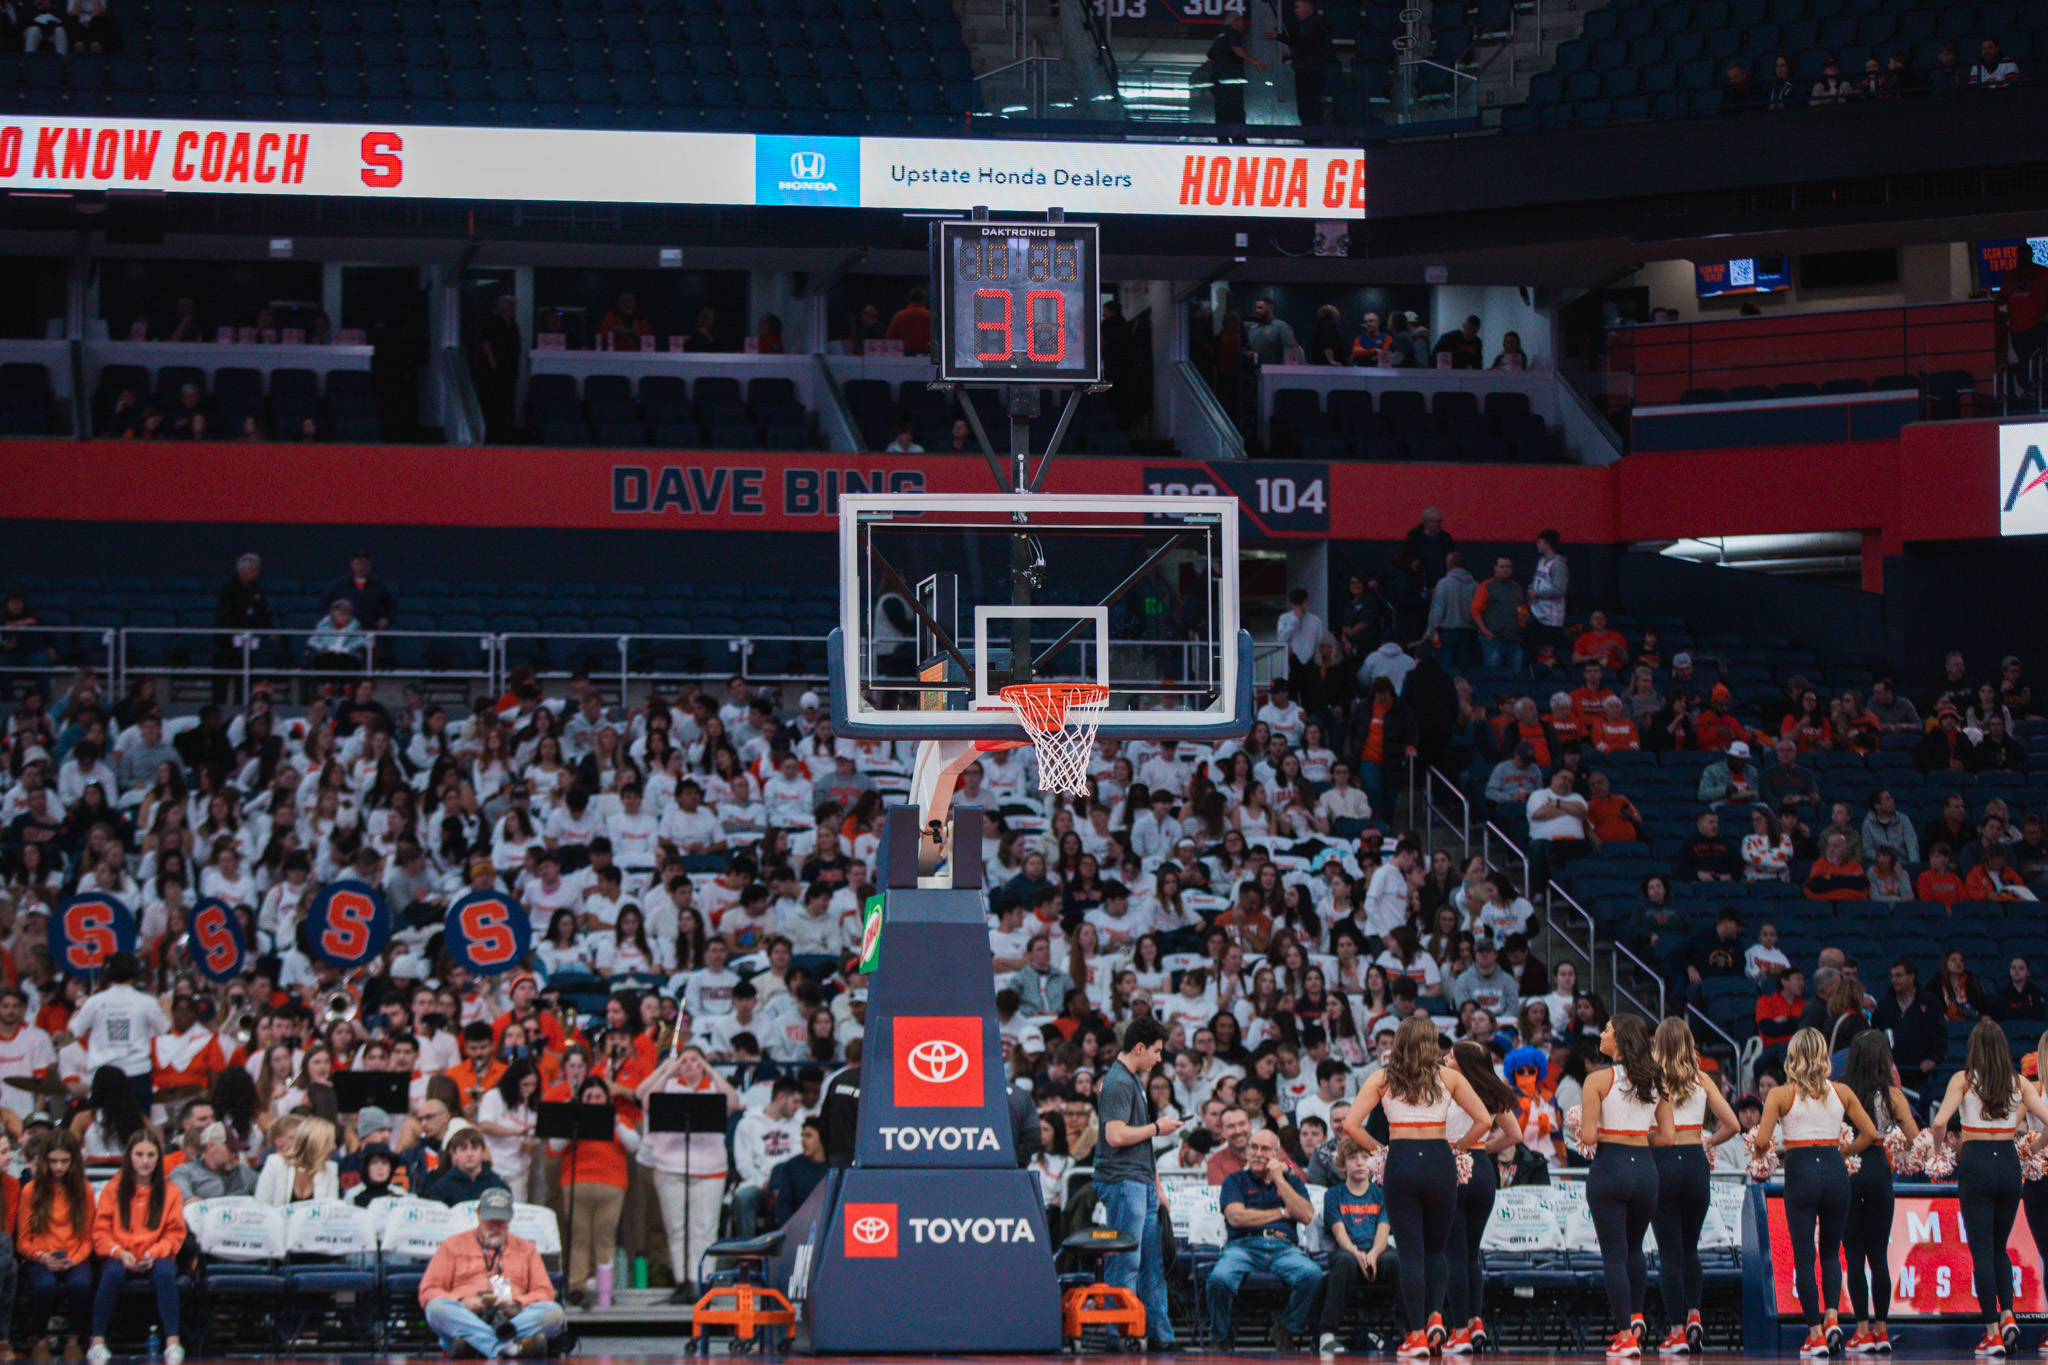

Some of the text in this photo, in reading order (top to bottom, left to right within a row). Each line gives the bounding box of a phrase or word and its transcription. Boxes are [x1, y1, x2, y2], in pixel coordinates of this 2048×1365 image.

[33, 127, 162, 181] KNOW
[171, 130, 310, 184] COACH
[360, 131, 403, 188] S
[891, 164, 1133, 188] Upstate Honda Dealers
[778, 181, 838, 192] HONDA
[1179, 155, 1309, 208] HONDA
[981, 228, 1056, 237] DAKTRONICS
[1982, 246, 2018, 261] SCAN HER
[1990, 258, 2017, 272] TO PLAY
[976, 288, 1066, 362] 30
[611, 465, 766, 516] DAVE
[1255, 477, 1327, 514] 104
[63, 901, 118, 970] S
[194, 904, 239, 975] S
[322, 888, 376, 961] S
[459, 898, 517, 966] S
[879, 1126, 1001, 1151] TOYOTA
[908, 1217, 1036, 1244] TOYOTA
[1339, 1203, 1382, 1216] SYRACUSE
